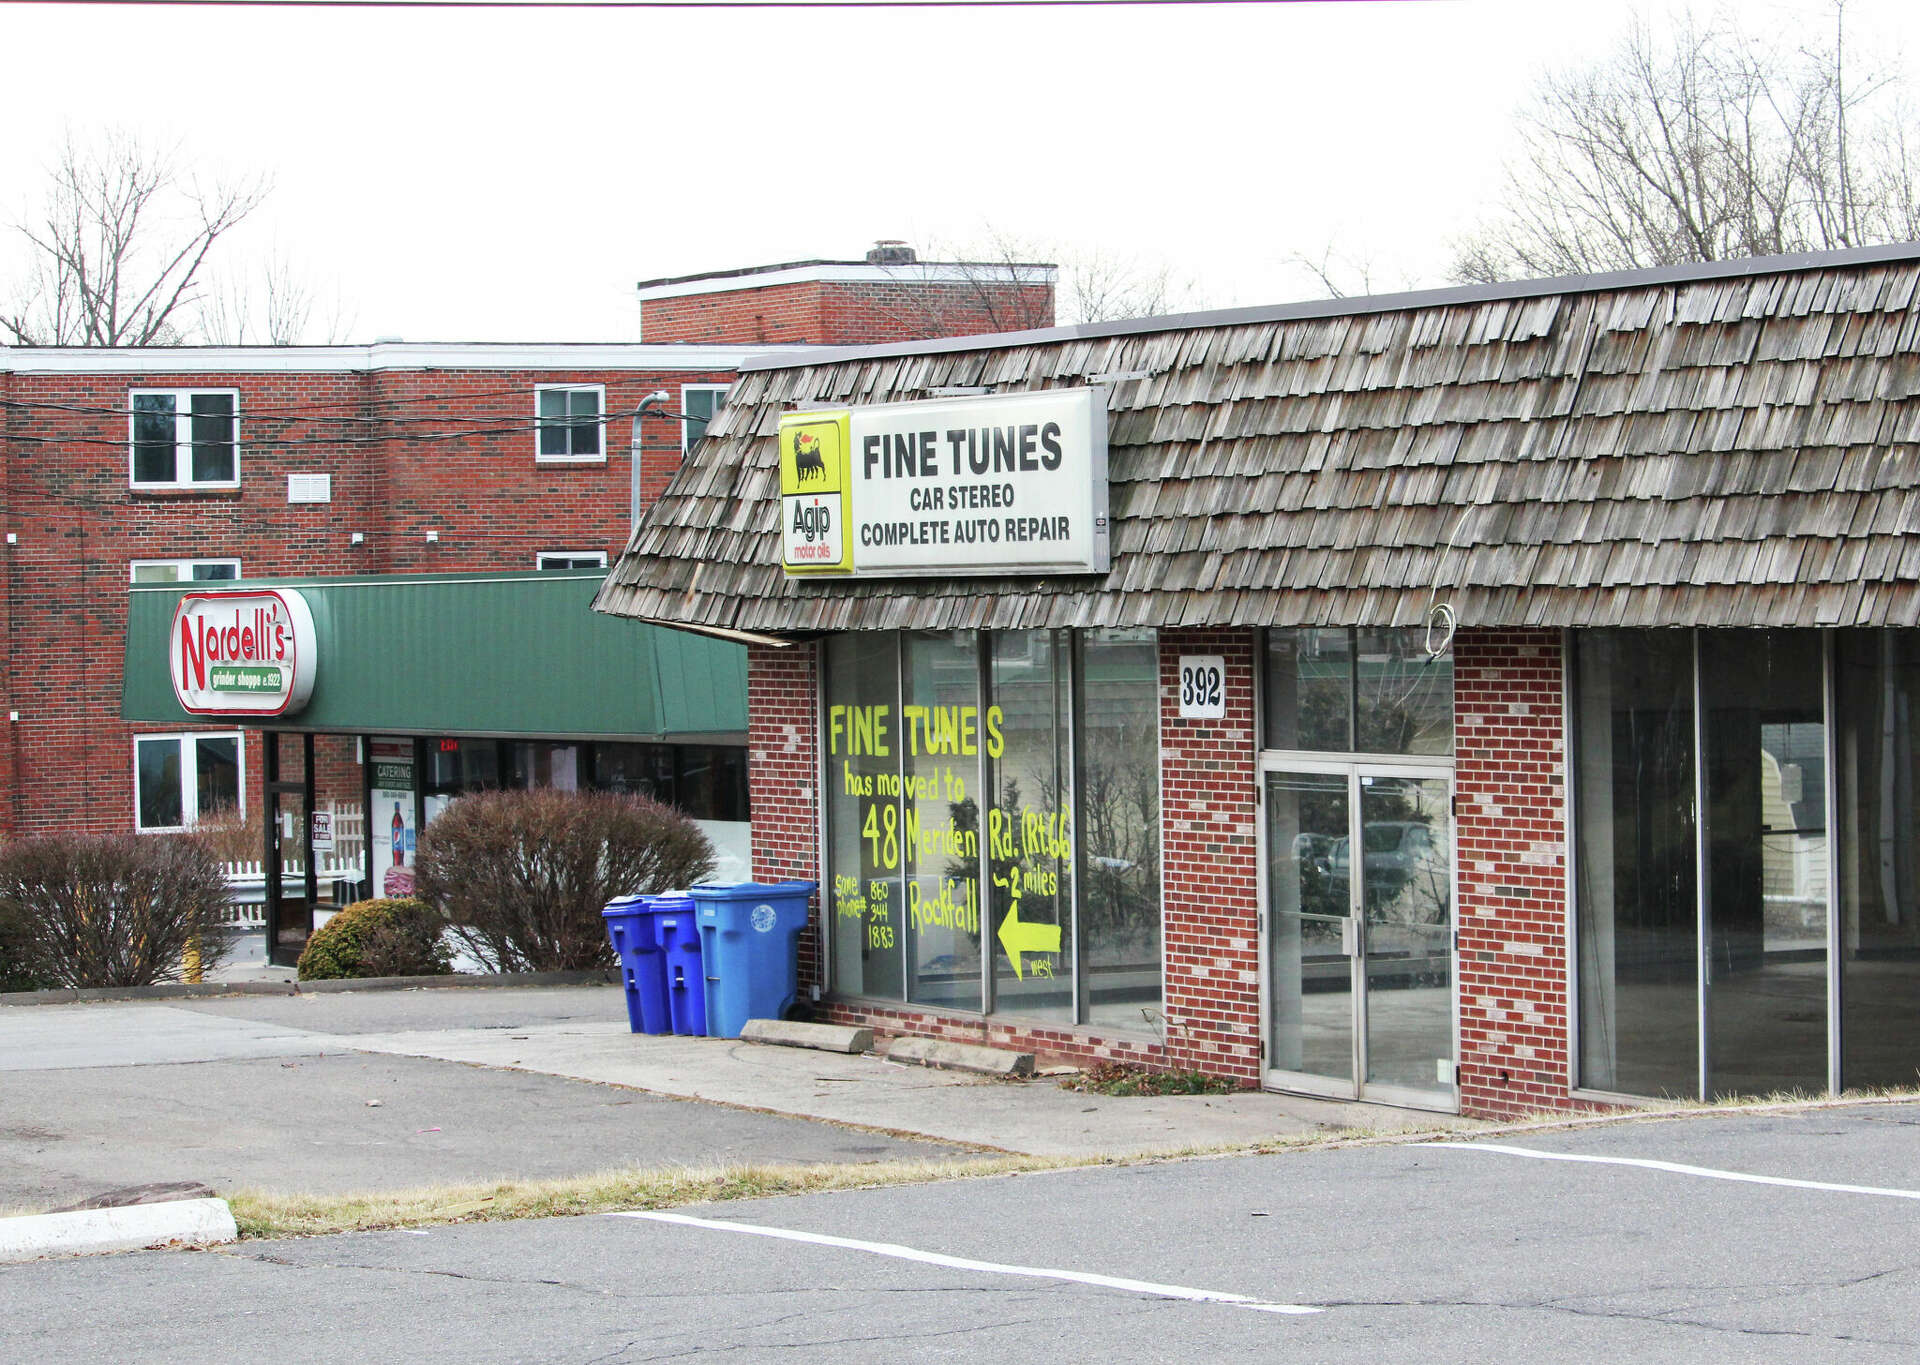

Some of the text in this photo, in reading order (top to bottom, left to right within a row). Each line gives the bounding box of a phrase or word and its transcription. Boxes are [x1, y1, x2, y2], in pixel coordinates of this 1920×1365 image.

[863, 421, 1063, 480] FINE TUNES
[910, 483, 1015, 511] CAR STEREO
[792, 498, 831, 542] Agip
[860, 520, 950, 546] COMPLETE
[954, 518, 1000, 544] AUTO
[1005, 516, 1070, 542] REPAIR
[793, 543, 831, 559] motor oils
[181, 603, 286, 691] Nardelli's
[212, 670, 235, 688] grinder
[237, 670, 261, 689] shoppe
[1183, 667, 1220, 706] 392
[830, 705, 1004, 759] FINE TUNES
[377, 765, 411, 779] CATERING
[844, 760, 965, 802] has moved to
[313, 823, 332, 833] SALE
[315, 815, 329, 824] FOR
[862, 803, 899, 870] 48
[906, 808, 977, 865] Meriden
[989, 808, 1019, 861] Rd.
[870, 881, 889, 901] 860
[1023, 863, 1057, 897] miles
[870, 902, 888, 923] 344
[909, 876, 977, 936] Rockfall
[868, 924, 895, 951] 1883
[1030, 956, 1054, 980] west
